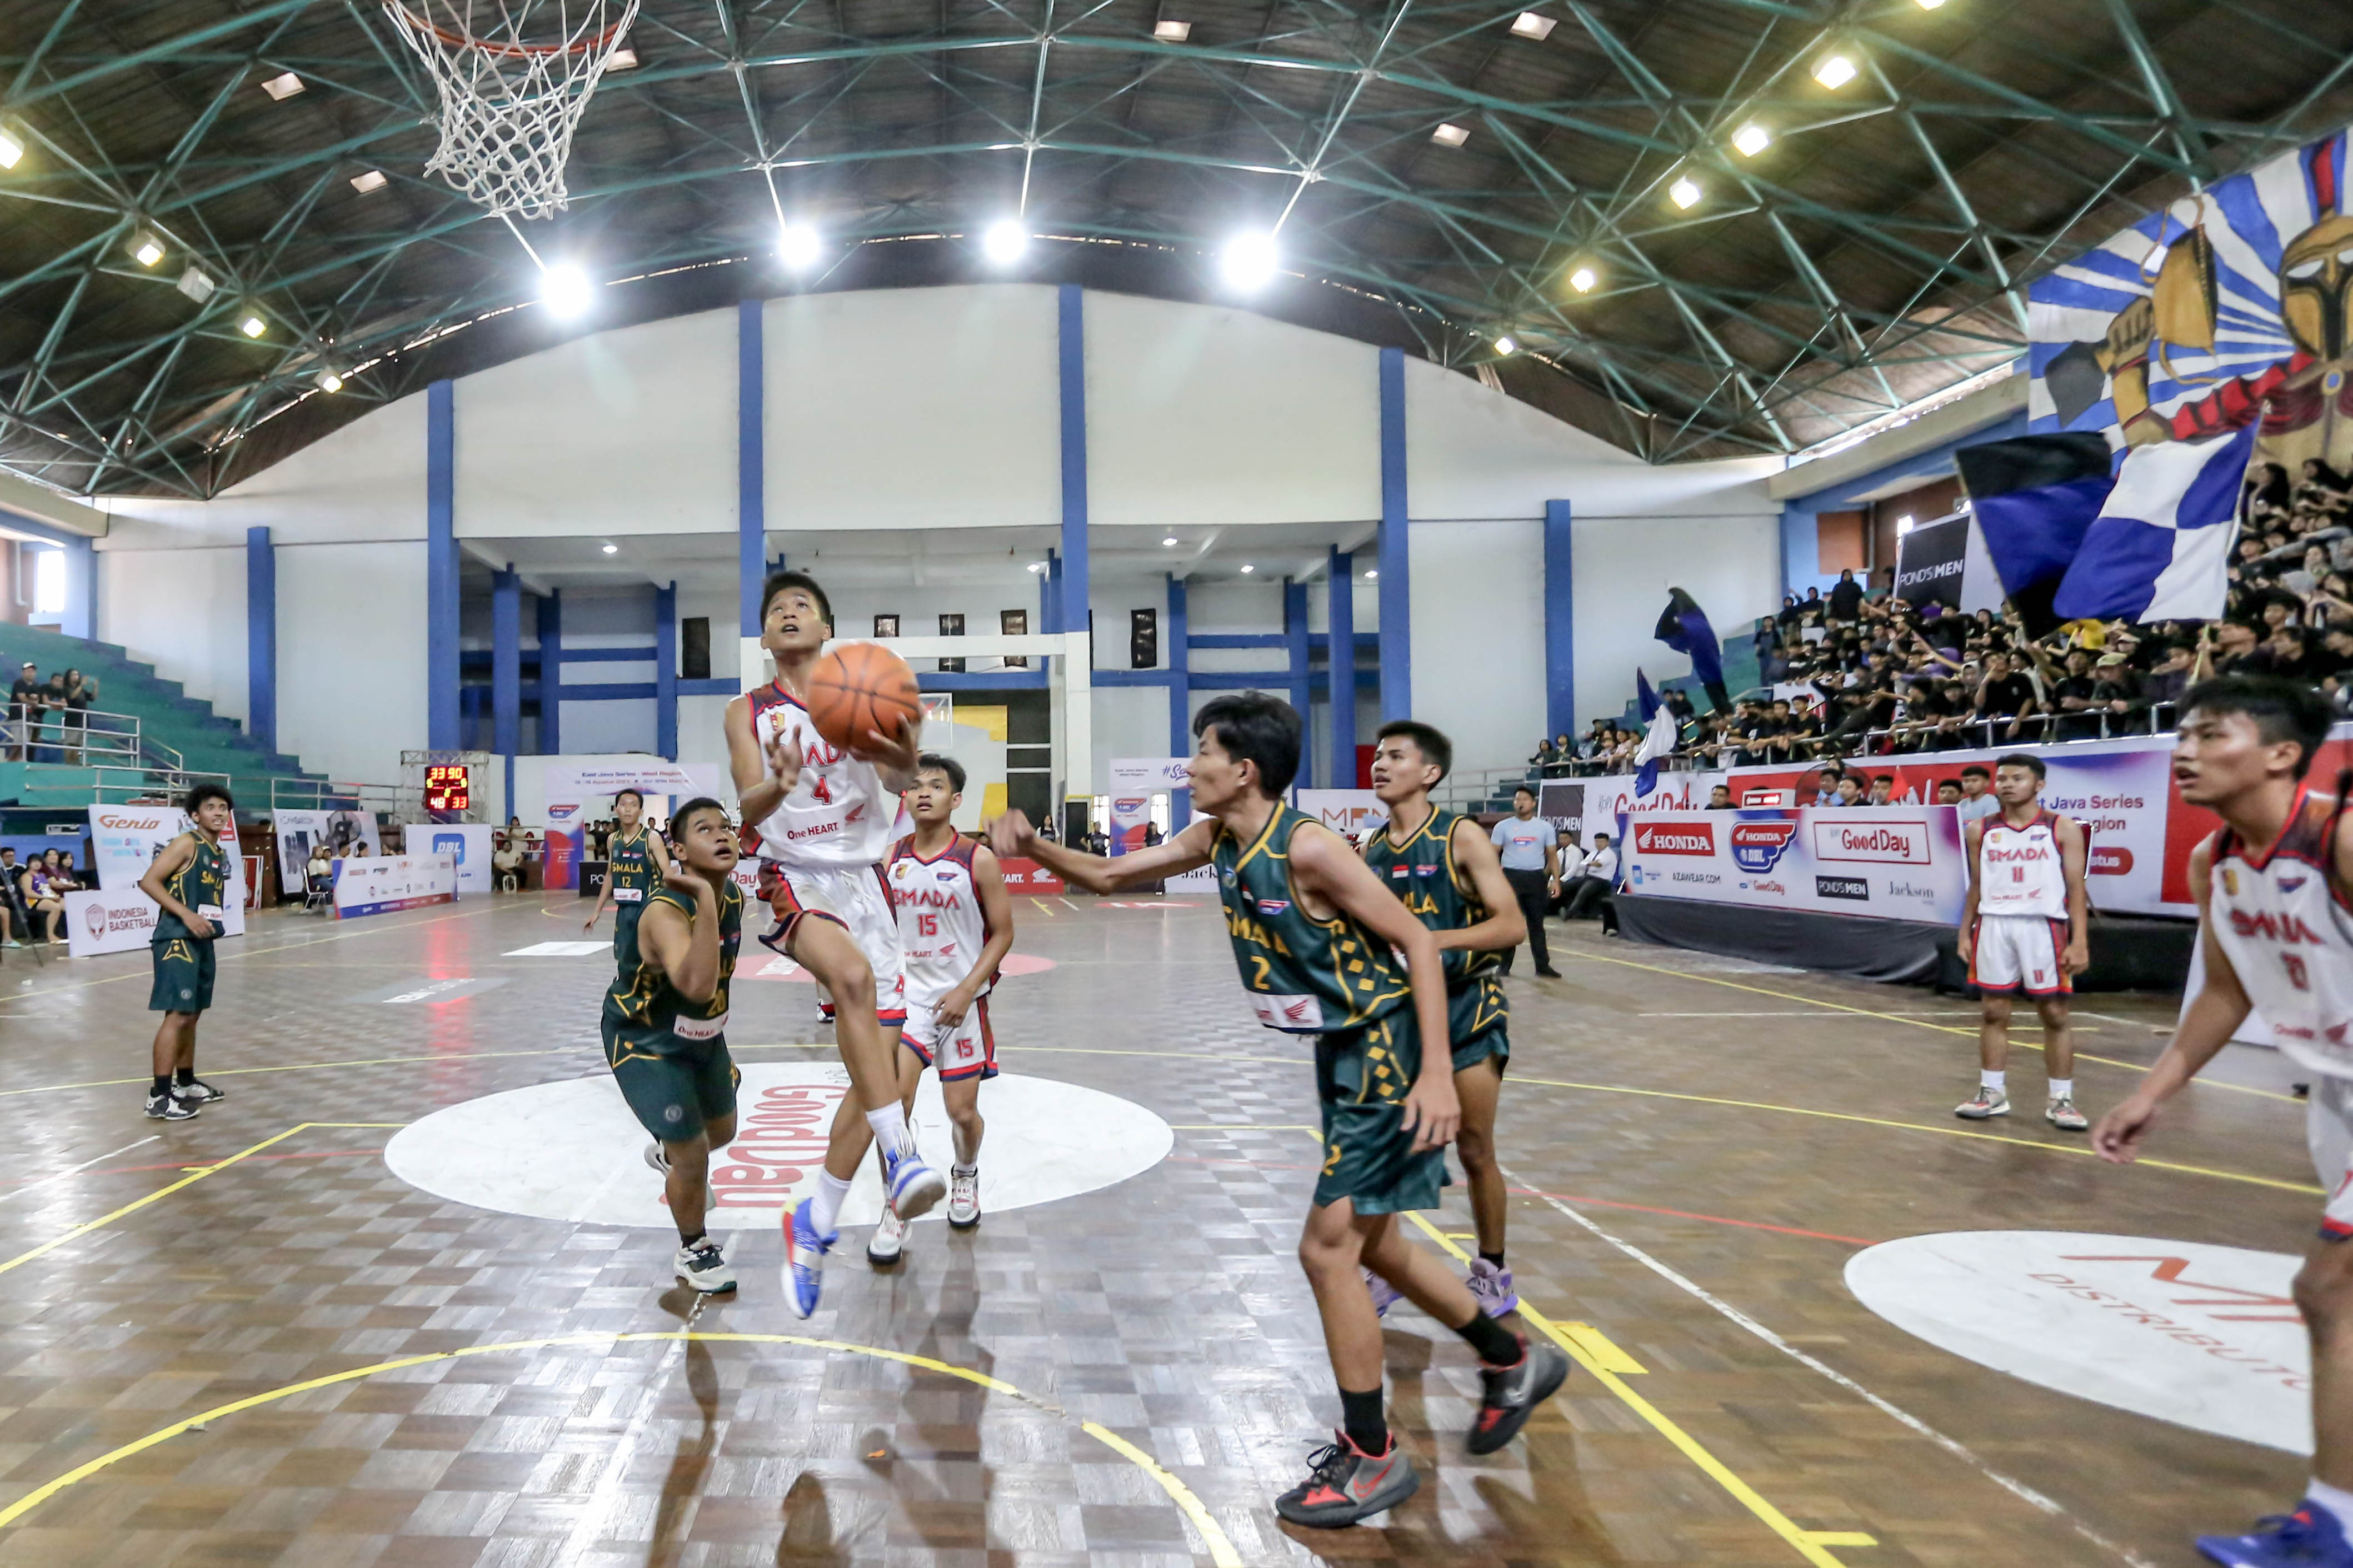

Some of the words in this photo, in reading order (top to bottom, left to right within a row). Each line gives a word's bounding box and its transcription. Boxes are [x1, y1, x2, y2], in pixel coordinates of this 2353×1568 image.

[447, 768, 463, 779] 90
[811, 774, 832, 805] 4
[430, 797, 446, 809] 48
[452, 796, 467, 809] 33
[2050, 796, 2086, 810] Java
[2090, 794, 2144, 809] Series
[99, 815, 161, 830] Genio
[787, 830, 806, 839] One
[1746, 833, 1781, 841] HONDA
[436, 842, 461, 853] DBL
[1653, 835, 1711, 851] HONDA
[612, 863, 643, 873] SMALA
[1182, 865, 1218, 879] Jack
[622, 876, 631, 888] 12
[1889, 881, 1934, 898] Jackson
[108, 907, 148, 920] INDONESIA
[918, 913, 938, 938] 15
[1251, 955, 1271, 990] 2
[956, 1038, 974, 1059] 15
